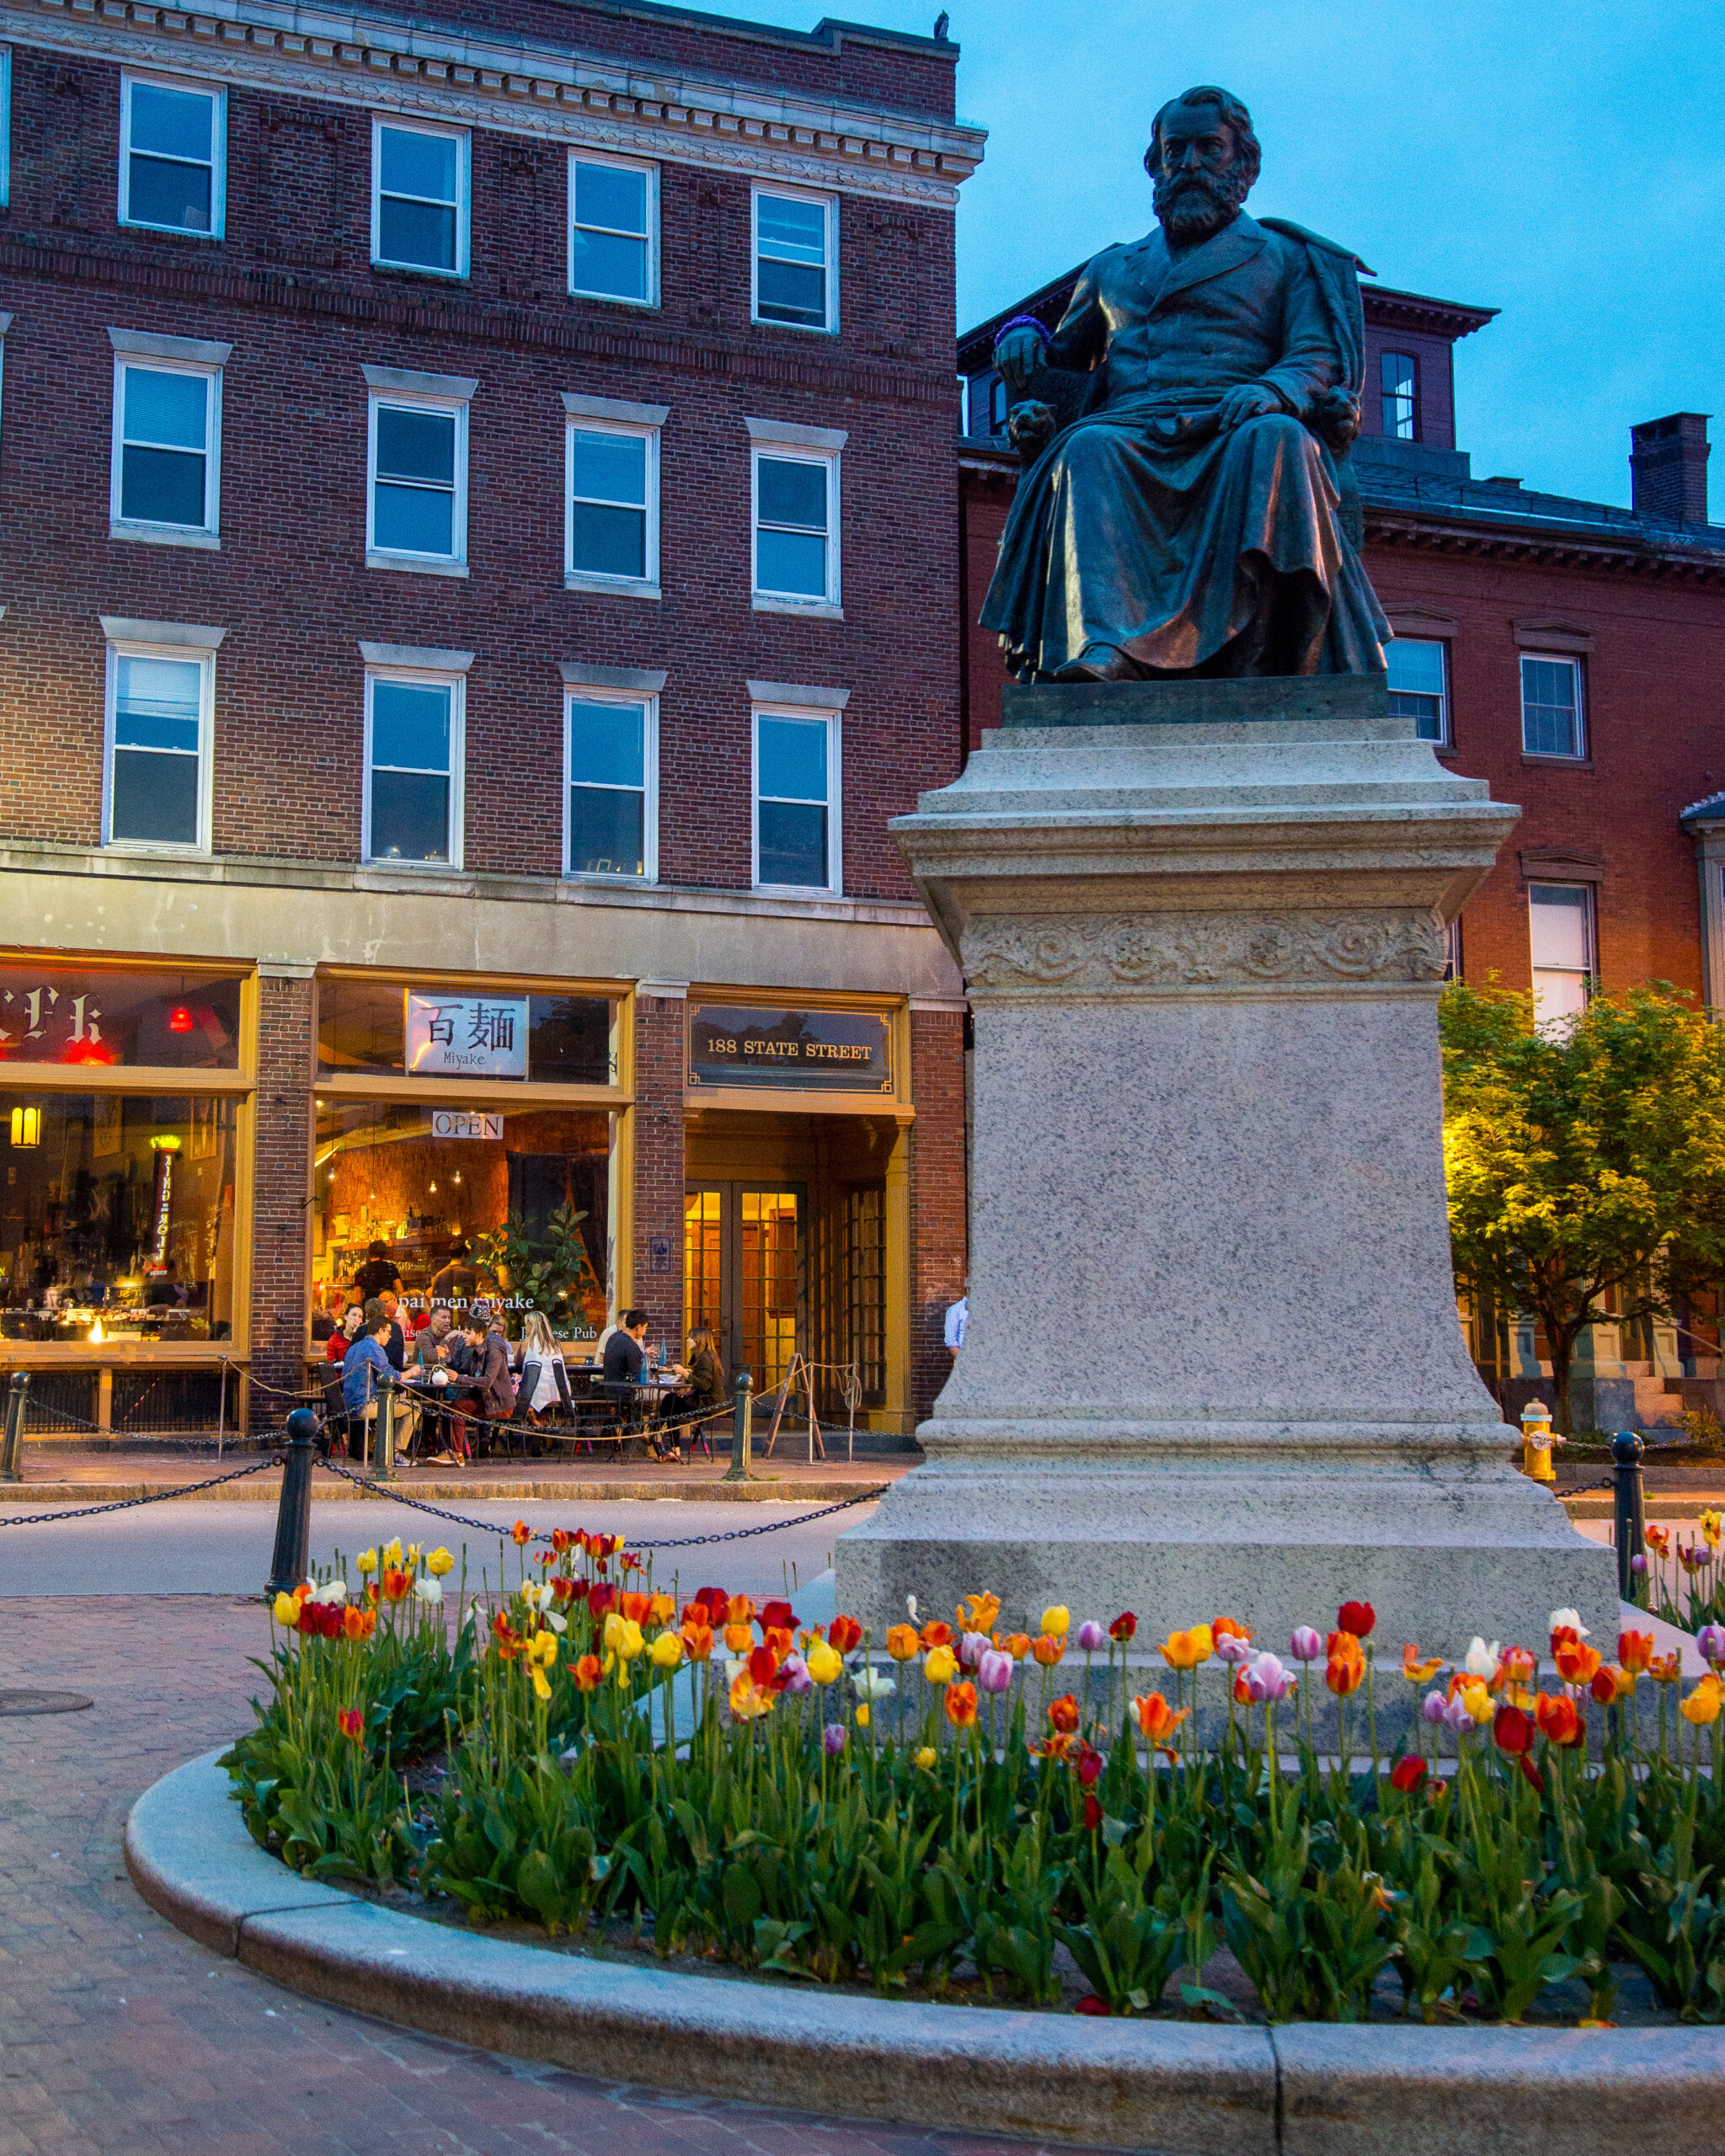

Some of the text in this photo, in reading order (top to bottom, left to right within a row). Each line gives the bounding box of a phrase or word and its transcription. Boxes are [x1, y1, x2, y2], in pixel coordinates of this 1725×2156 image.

[708, 1038, 873, 1059] 188 STATE STREET
[444, 1052, 486, 1070] Miyake
[435, 1114, 500, 1136] OPEN
[398, 1293, 425, 1314] pai
[430, 1297, 467, 1309] men
[574, 1326, 597, 1339] Pub
